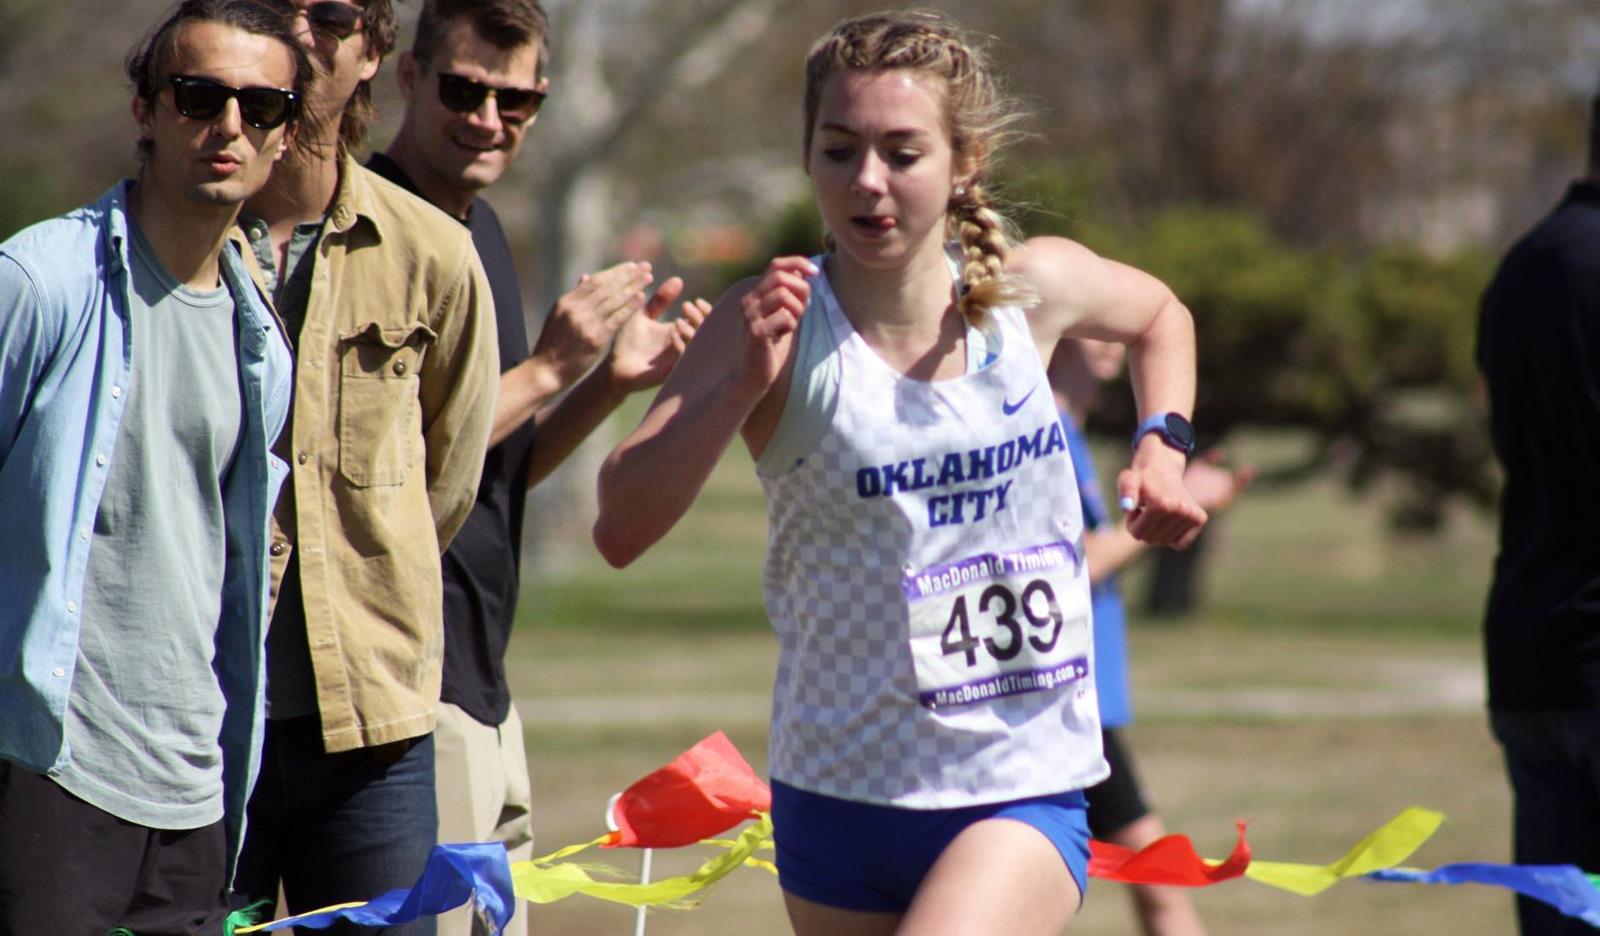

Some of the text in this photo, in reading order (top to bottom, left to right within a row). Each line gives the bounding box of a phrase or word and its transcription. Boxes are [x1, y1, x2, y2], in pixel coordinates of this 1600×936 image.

[857, 421, 1066, 498] OKLAHOMA
[927, 479, 1013, 527] CITY
[916, 549, 1065, 597] MacDonald Timing
[940, 579, 1063, 667] 439
[935, 664, 1076, 705] MacDonaldTiming.com
